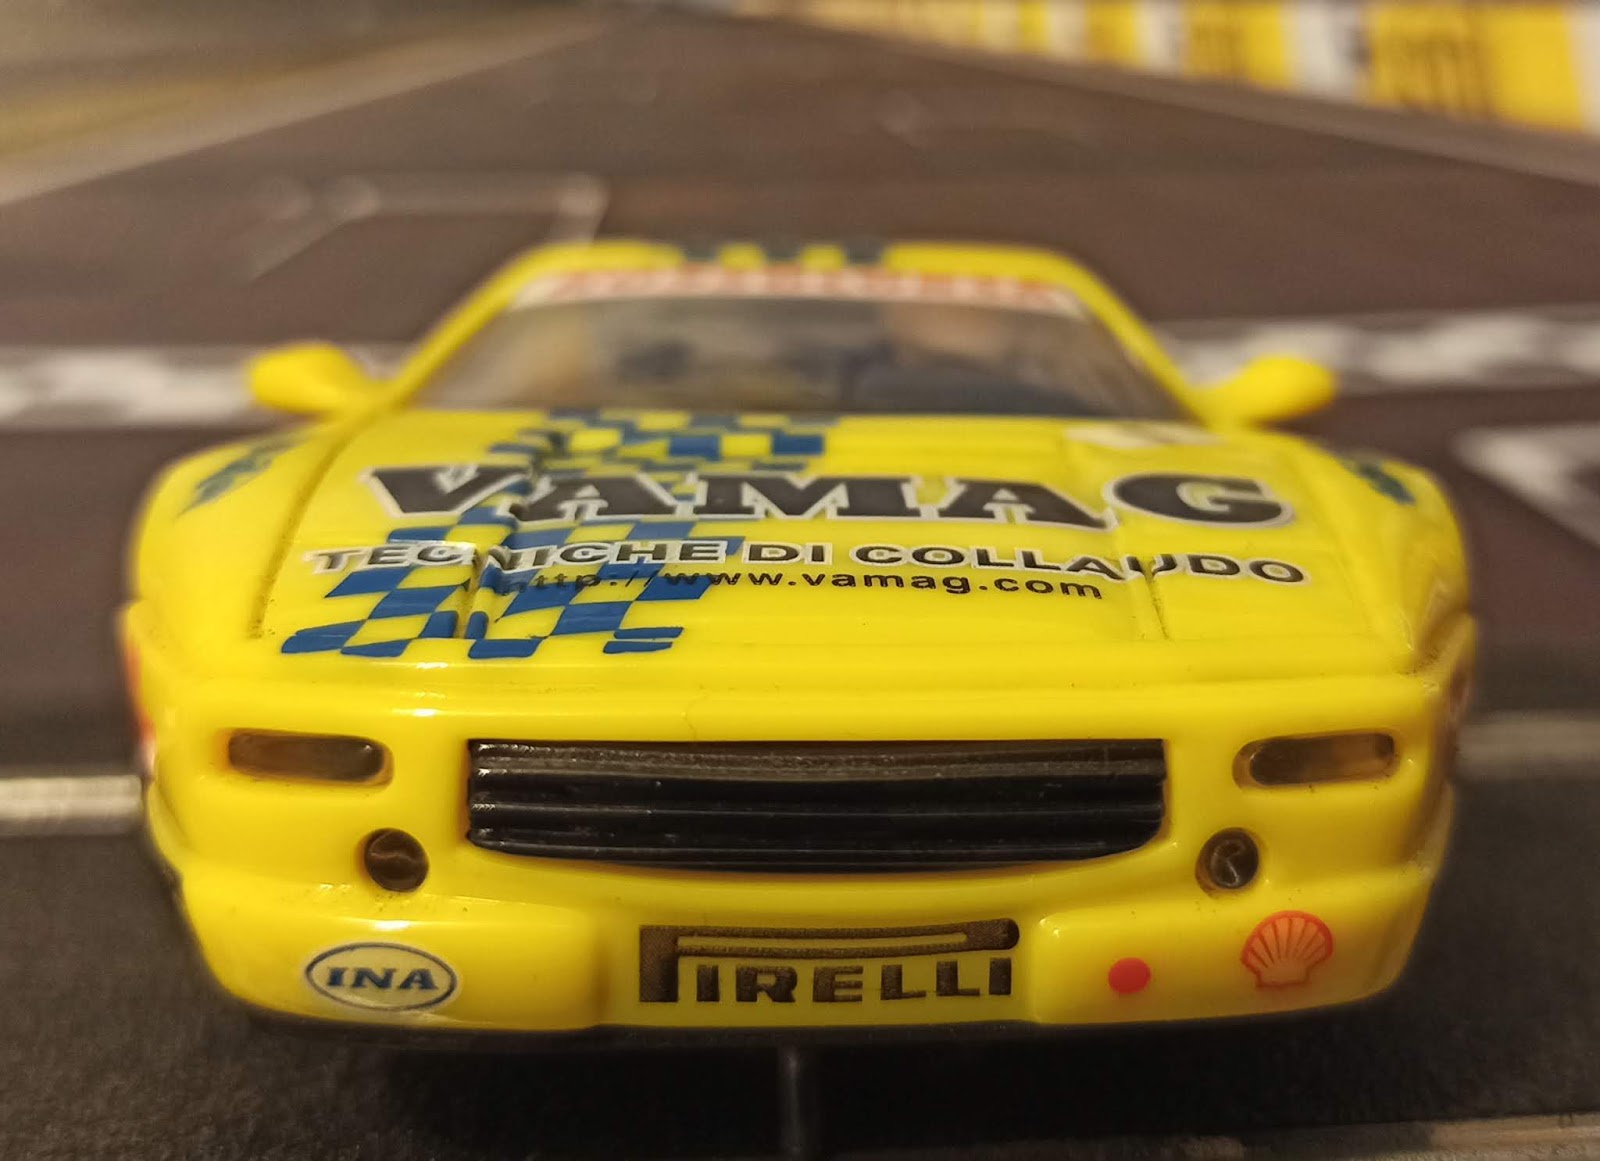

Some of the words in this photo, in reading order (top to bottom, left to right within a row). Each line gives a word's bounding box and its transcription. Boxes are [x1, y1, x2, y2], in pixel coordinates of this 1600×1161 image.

[366, 464, 1294, 529] VAMAG
[308, 541, 728, 574] TECNICHE
[742, 541, 832, 565] DI
[850, 543, 1309, 584] COLLAUDO
[326, 966, 439, 991] INA
[639, 918, 1020, 1003] PIRELLI
